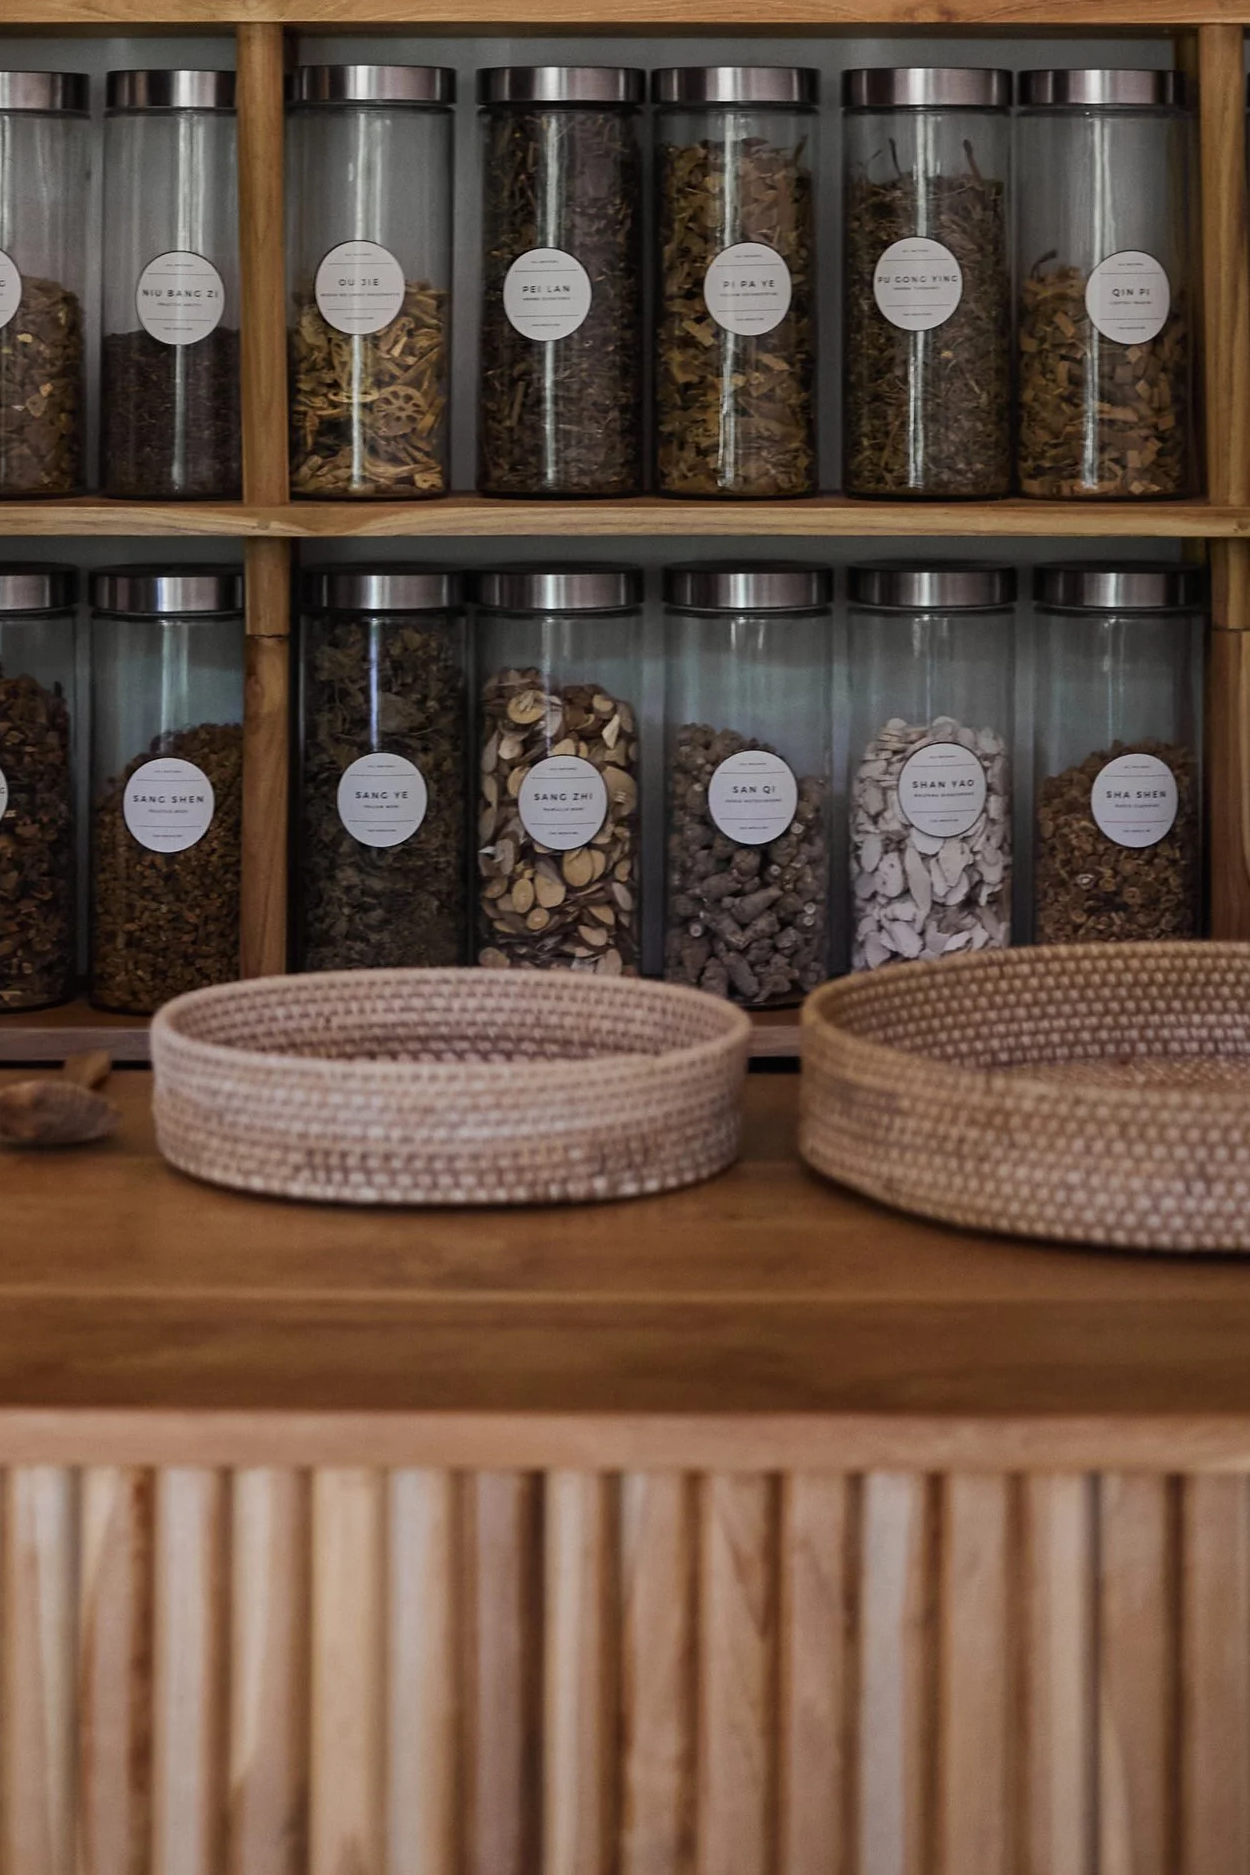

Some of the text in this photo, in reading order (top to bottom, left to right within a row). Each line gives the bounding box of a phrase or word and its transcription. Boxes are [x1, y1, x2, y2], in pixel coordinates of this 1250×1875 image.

[361, 278, 379, 286] JIE
[762, 280, 774, 288] YE
[142, 289, 218, 298] NIU BANG ZI
[1111, 288, 1150, 297] QIN PI
[912, 779, 975, 789] SHAN YAO
[762, 786, 775, 794] QI
[355, 791, 408, 799] SANG YE
[534, 793, 593, 801] SANG ZHI
[1106, 790, 1166, 799] SHA SHEN
[133, 795, 204, 804] SANG SHEN
